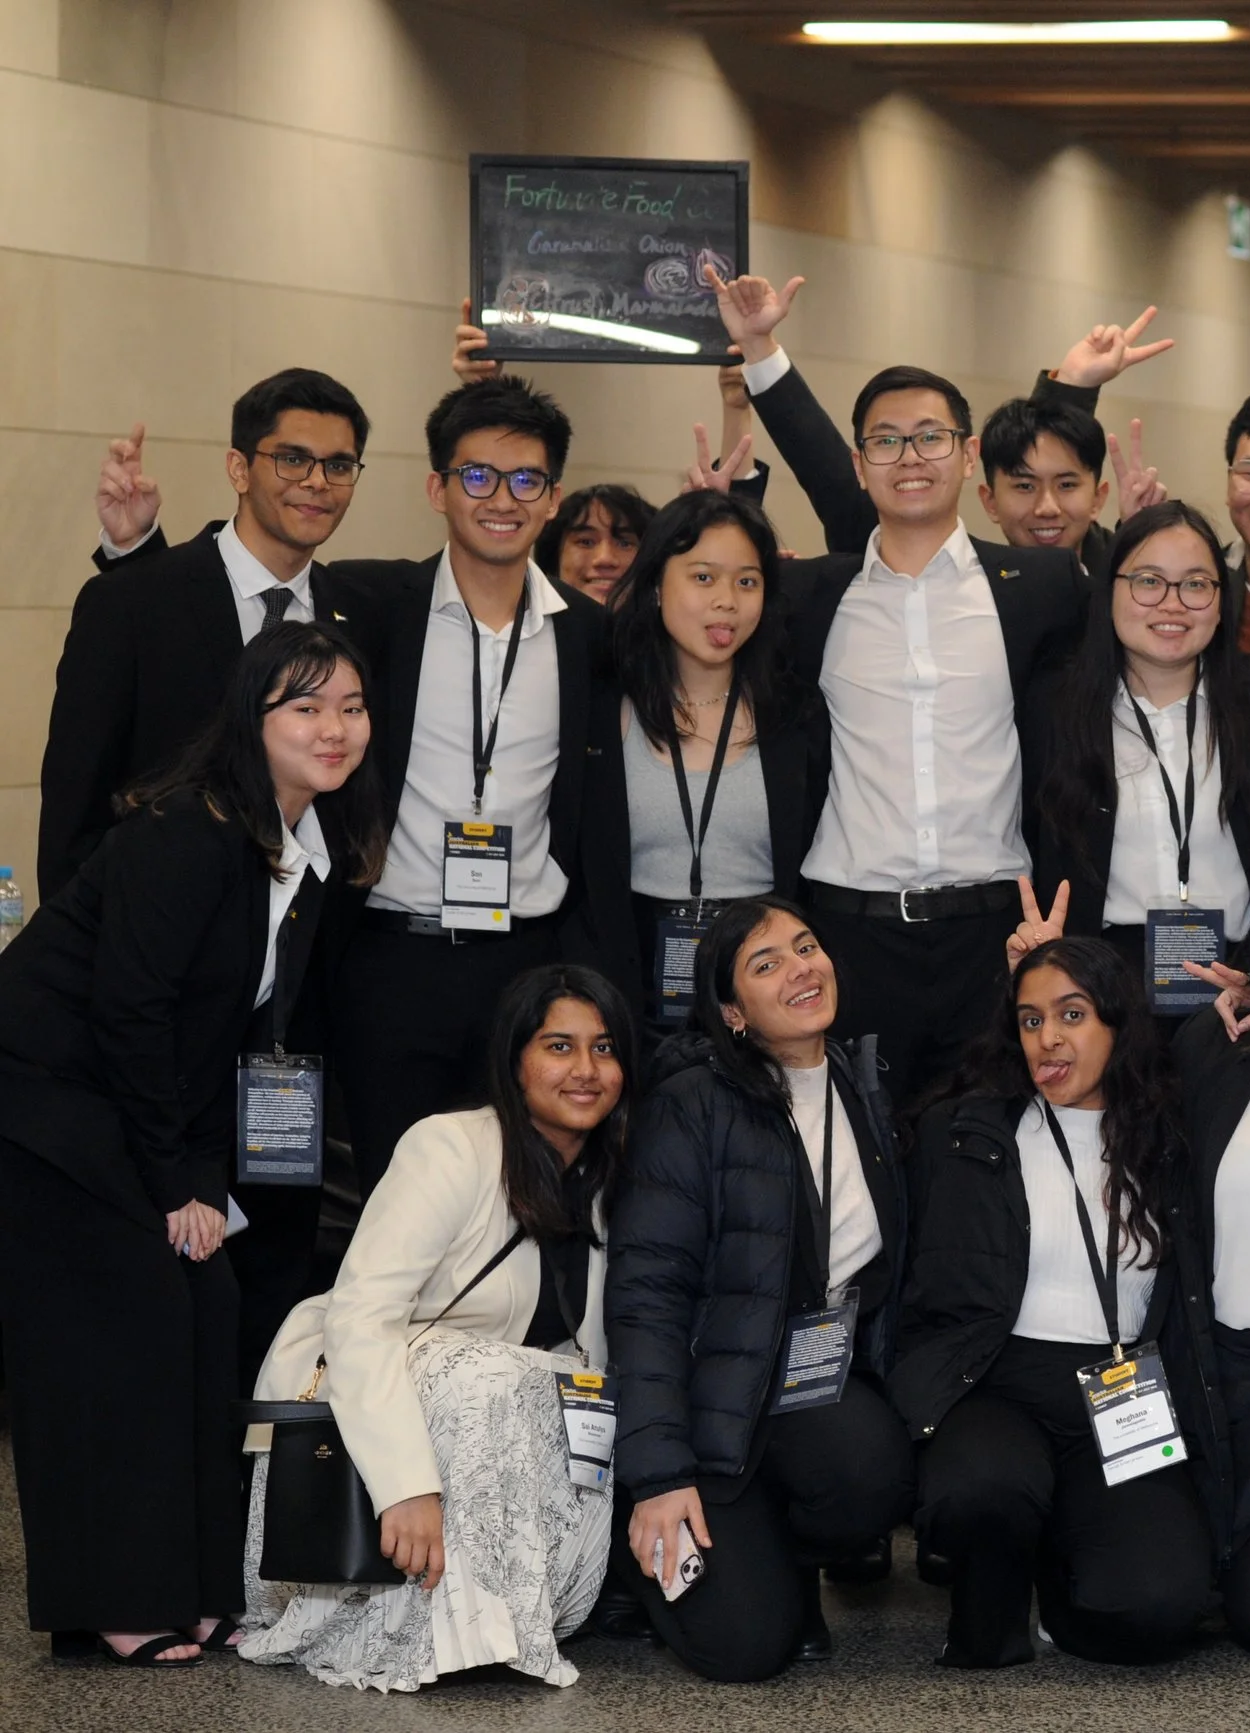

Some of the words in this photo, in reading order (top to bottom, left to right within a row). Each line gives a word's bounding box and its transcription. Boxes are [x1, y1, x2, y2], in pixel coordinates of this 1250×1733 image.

[622, 181, 682, 220] Food
[639, 234, 689, 256] Onion
[1115, 1408, 1148, 1426] Meghana
